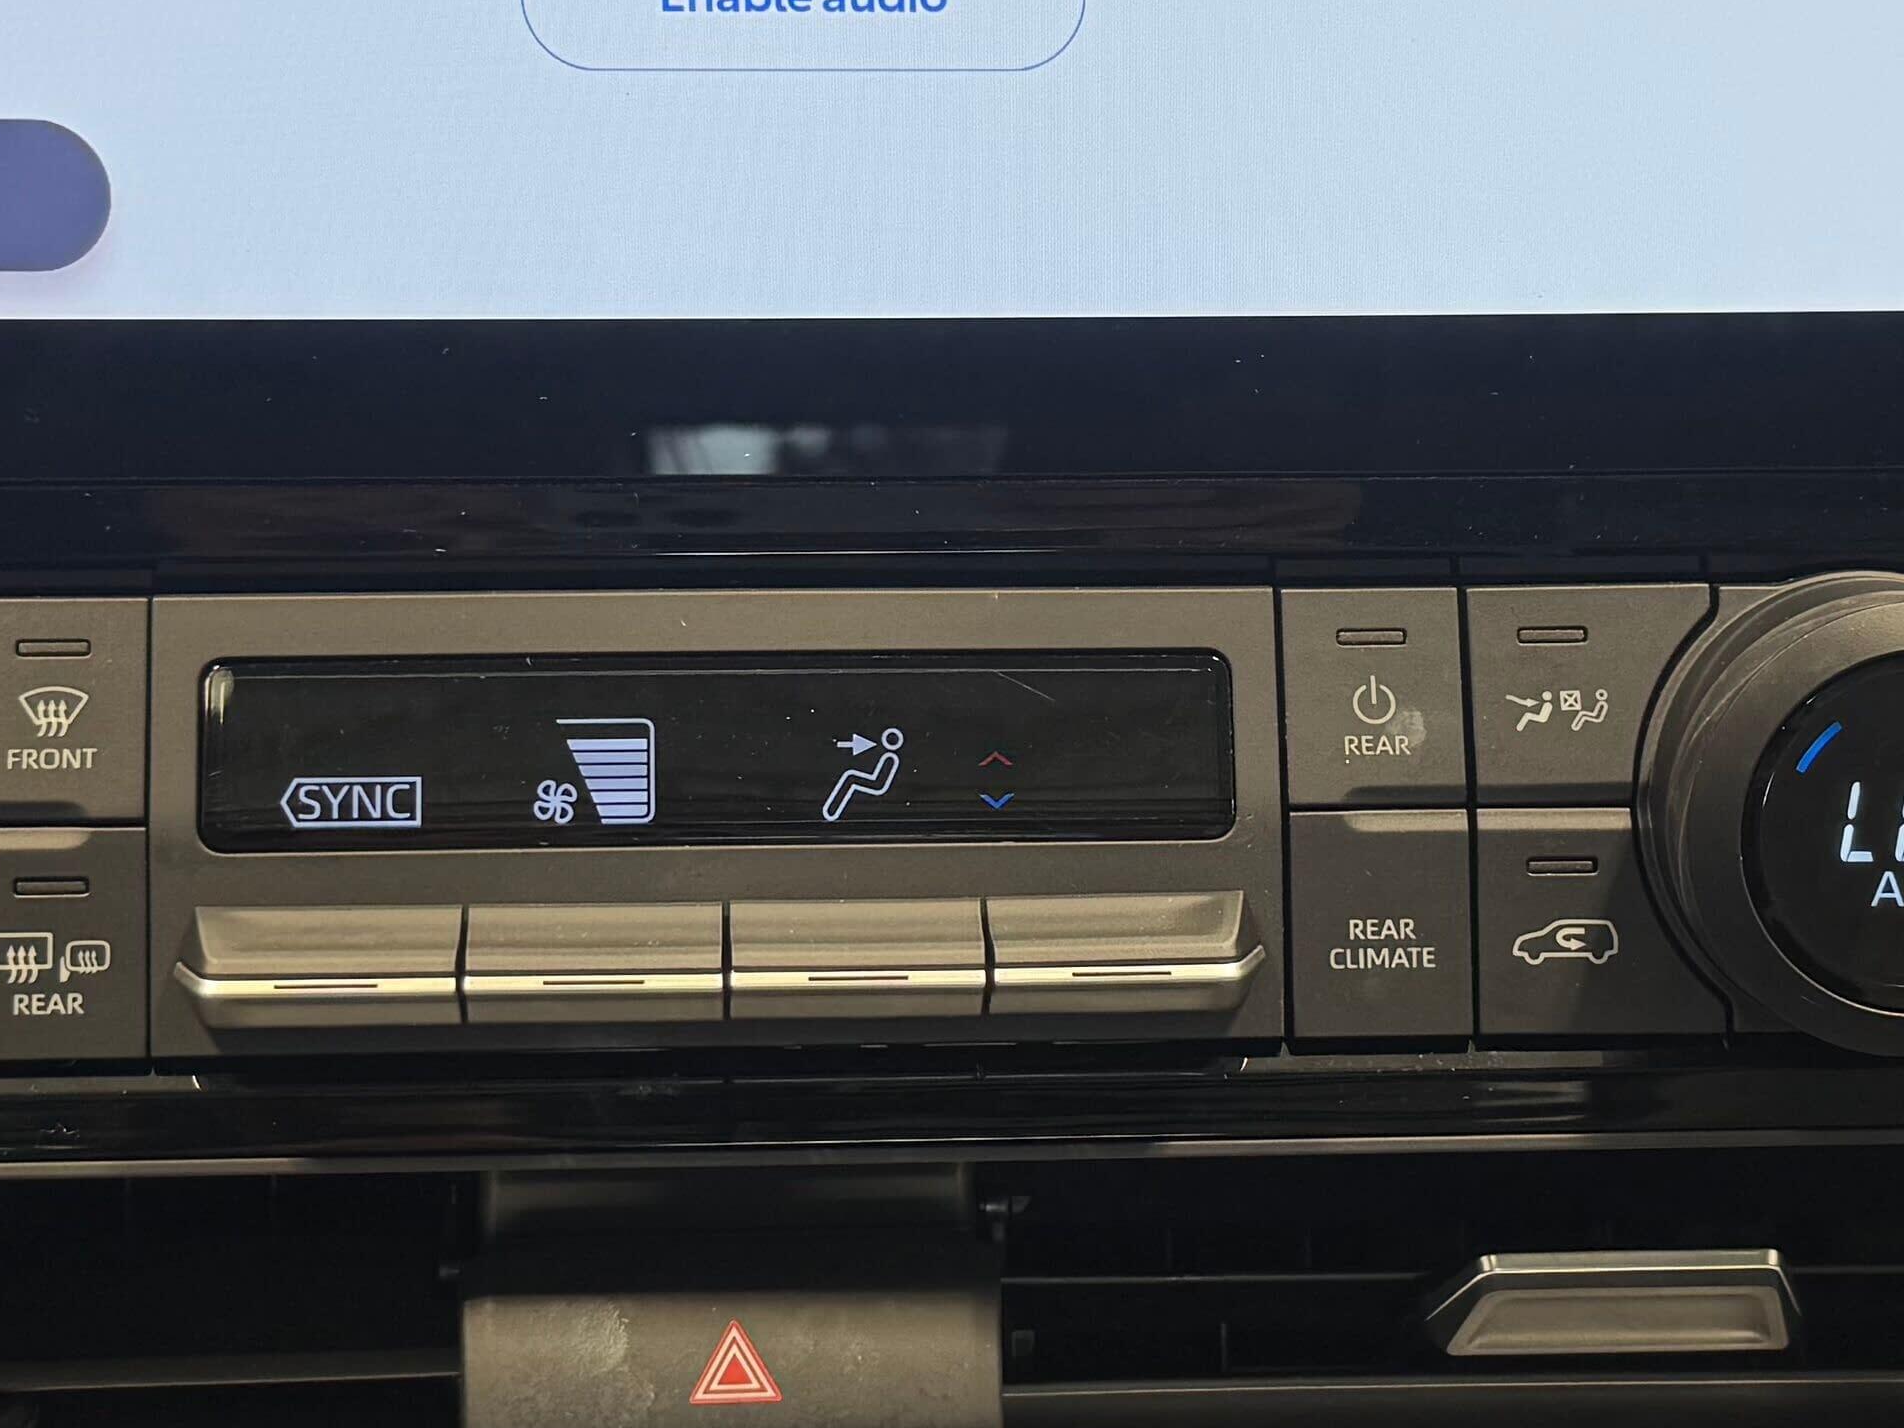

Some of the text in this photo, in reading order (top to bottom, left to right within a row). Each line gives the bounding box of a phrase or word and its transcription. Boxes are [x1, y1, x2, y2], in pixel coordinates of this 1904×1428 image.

[1344, 734, 1412, 757] REAR
[6, 747, 98, 771] FRONT
[297, 782, 411, 823] SYNC
[1349, 918, 1417, 941] REAR
[1329, 943, 1436, 971] CLIMATE
[12, 993, 85, 1017] REAR
